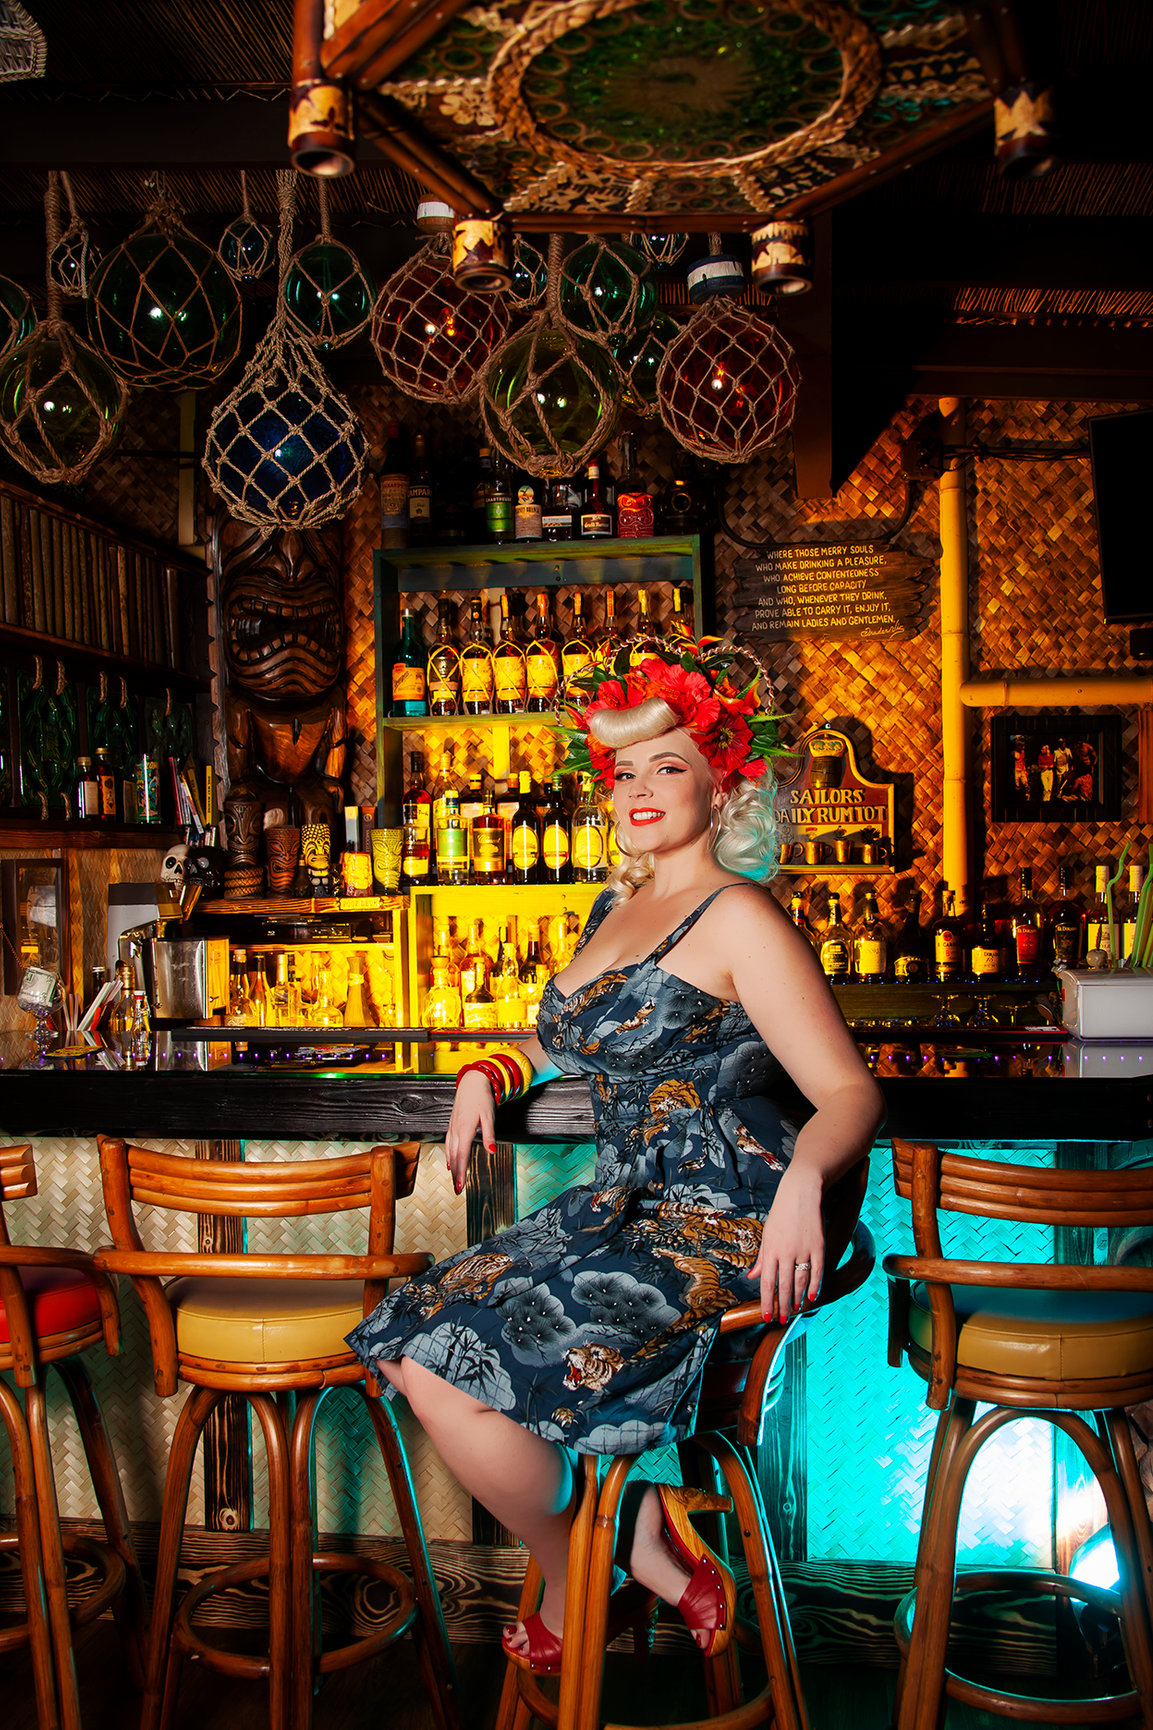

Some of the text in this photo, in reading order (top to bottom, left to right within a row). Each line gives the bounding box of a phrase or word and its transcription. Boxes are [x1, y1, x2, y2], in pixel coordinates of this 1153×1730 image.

[767, 544, 874, 559] WHERE THOSE MERRY SOULS
[755, 554, 887, 572] WHO MAKE DRINKING A PLEASURE,
[763, 567, 880, 583] WHO ACHIEVE CONTENTEDNESS
[777, 579, 867, 594] LONG BEFORE CAPACITY
[758, 597, 774, 607] AND
[776, 596, 796, 606] WHO,
[797, 592, 838, 604] WHENEVER
[840, 592, 860, 602] THEY
[755, 608, 780, 619] PROVE
[781, 607, 801, 617] ABLE
[802, 606, 813, 616] TO
[815, 604, 841, 616] CARRY
[843, 604, 853, 614] IT,
[855, 602, 880, 613] ENJOY
[751, 621, 768, 632] AND
[769, 619, 800, 630] REMAIN
[801, 617, 829, 628] LADIES
[830, 617, 847, 627] AND
[790, 788, 864, 804] SAILORS
[816, 806, 854, 823] RUM
